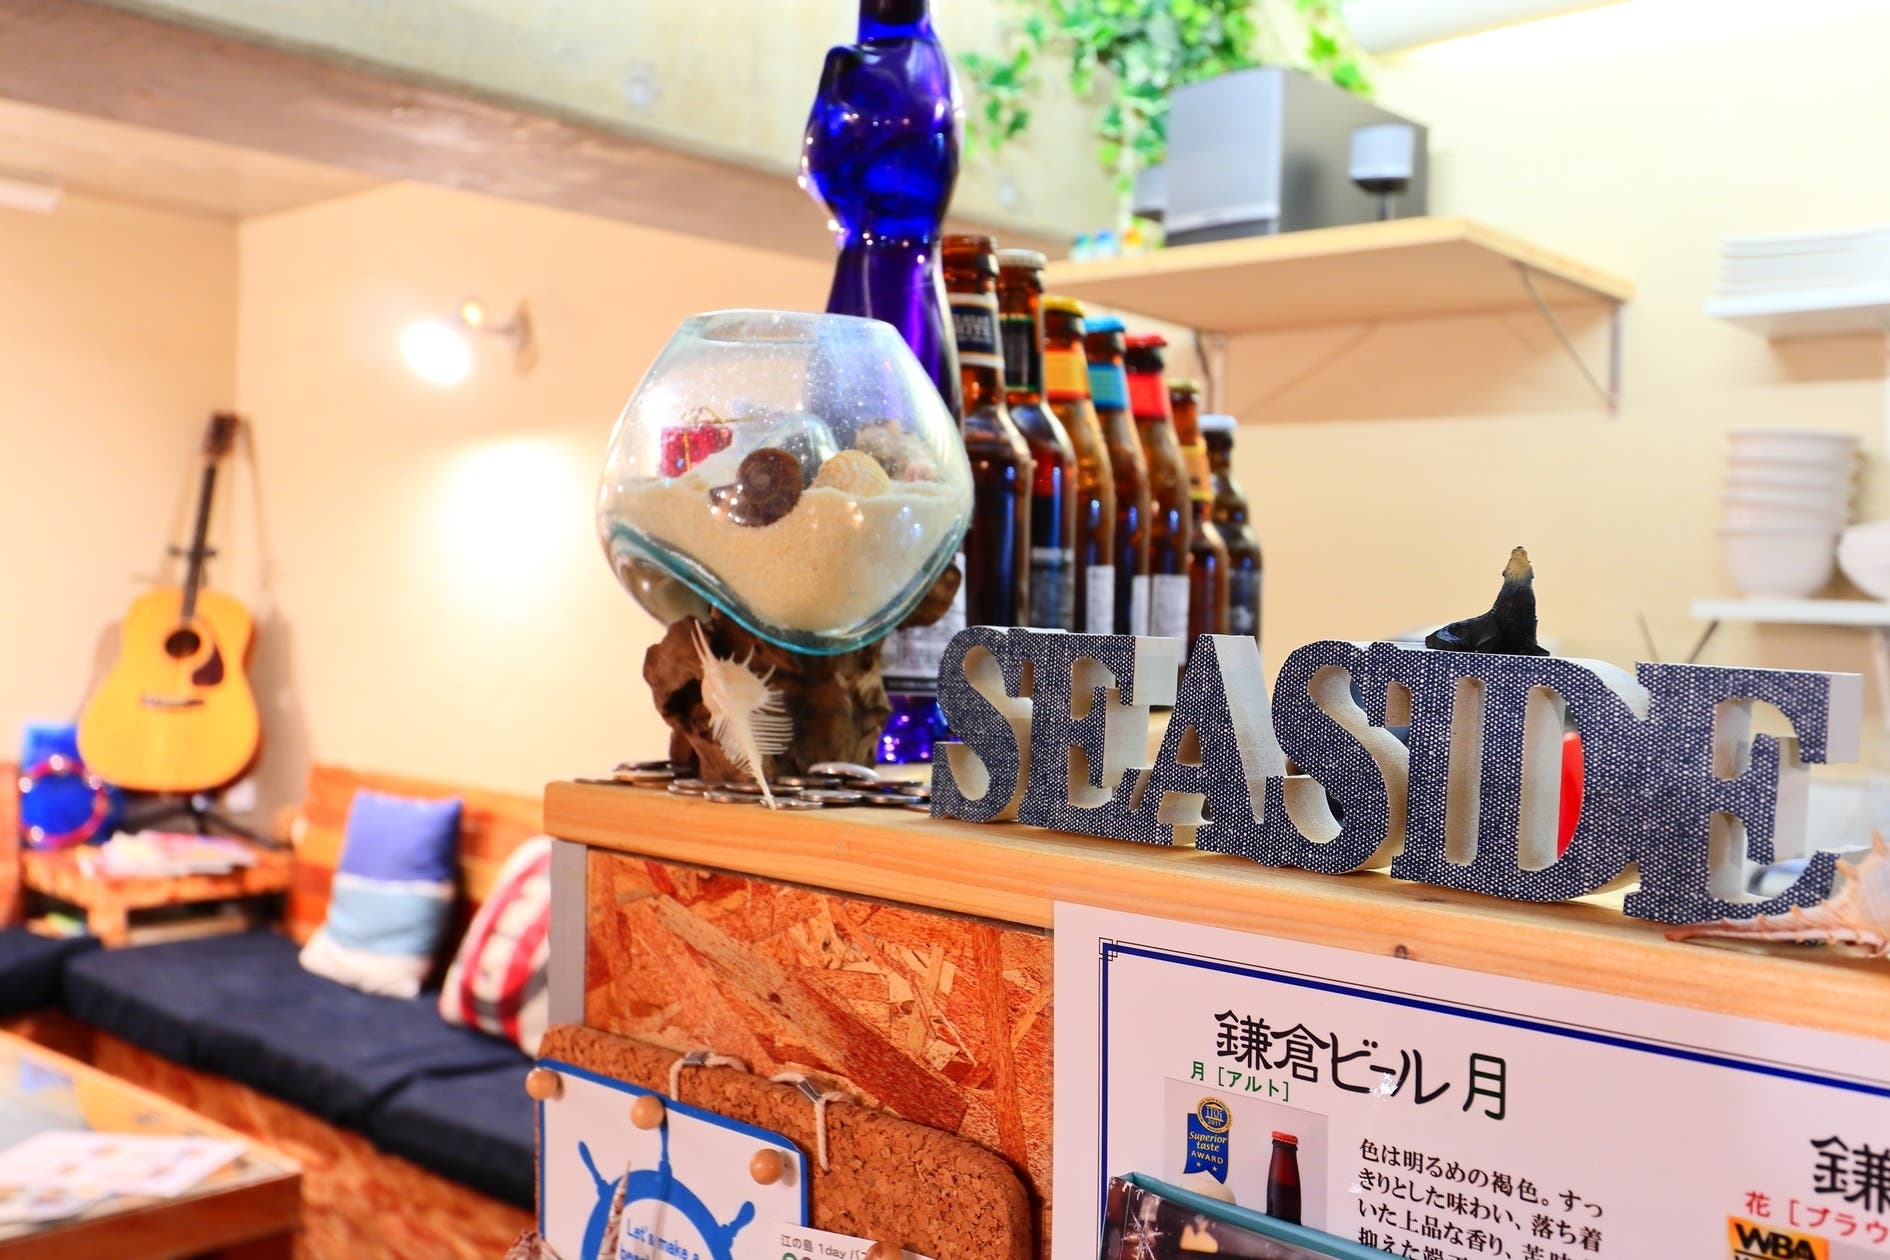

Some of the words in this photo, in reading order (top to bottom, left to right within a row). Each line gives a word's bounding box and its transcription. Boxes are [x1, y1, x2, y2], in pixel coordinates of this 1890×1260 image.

[931, 625, 1861, 924] SEASIDE
[1214, 1009, 1450, 1105] 鎌倉ビール
[1462, 1052, 1506, 1121] 月
[1188, 1131, 1228, 1144] Superior
[1196, 1141, 1220, 1152] taste
[1191, 1150, 1224, 1165] AWARD
[781, 1234, 814, 1253] 江の島
[819, 1243, 846, 1259] 1day
